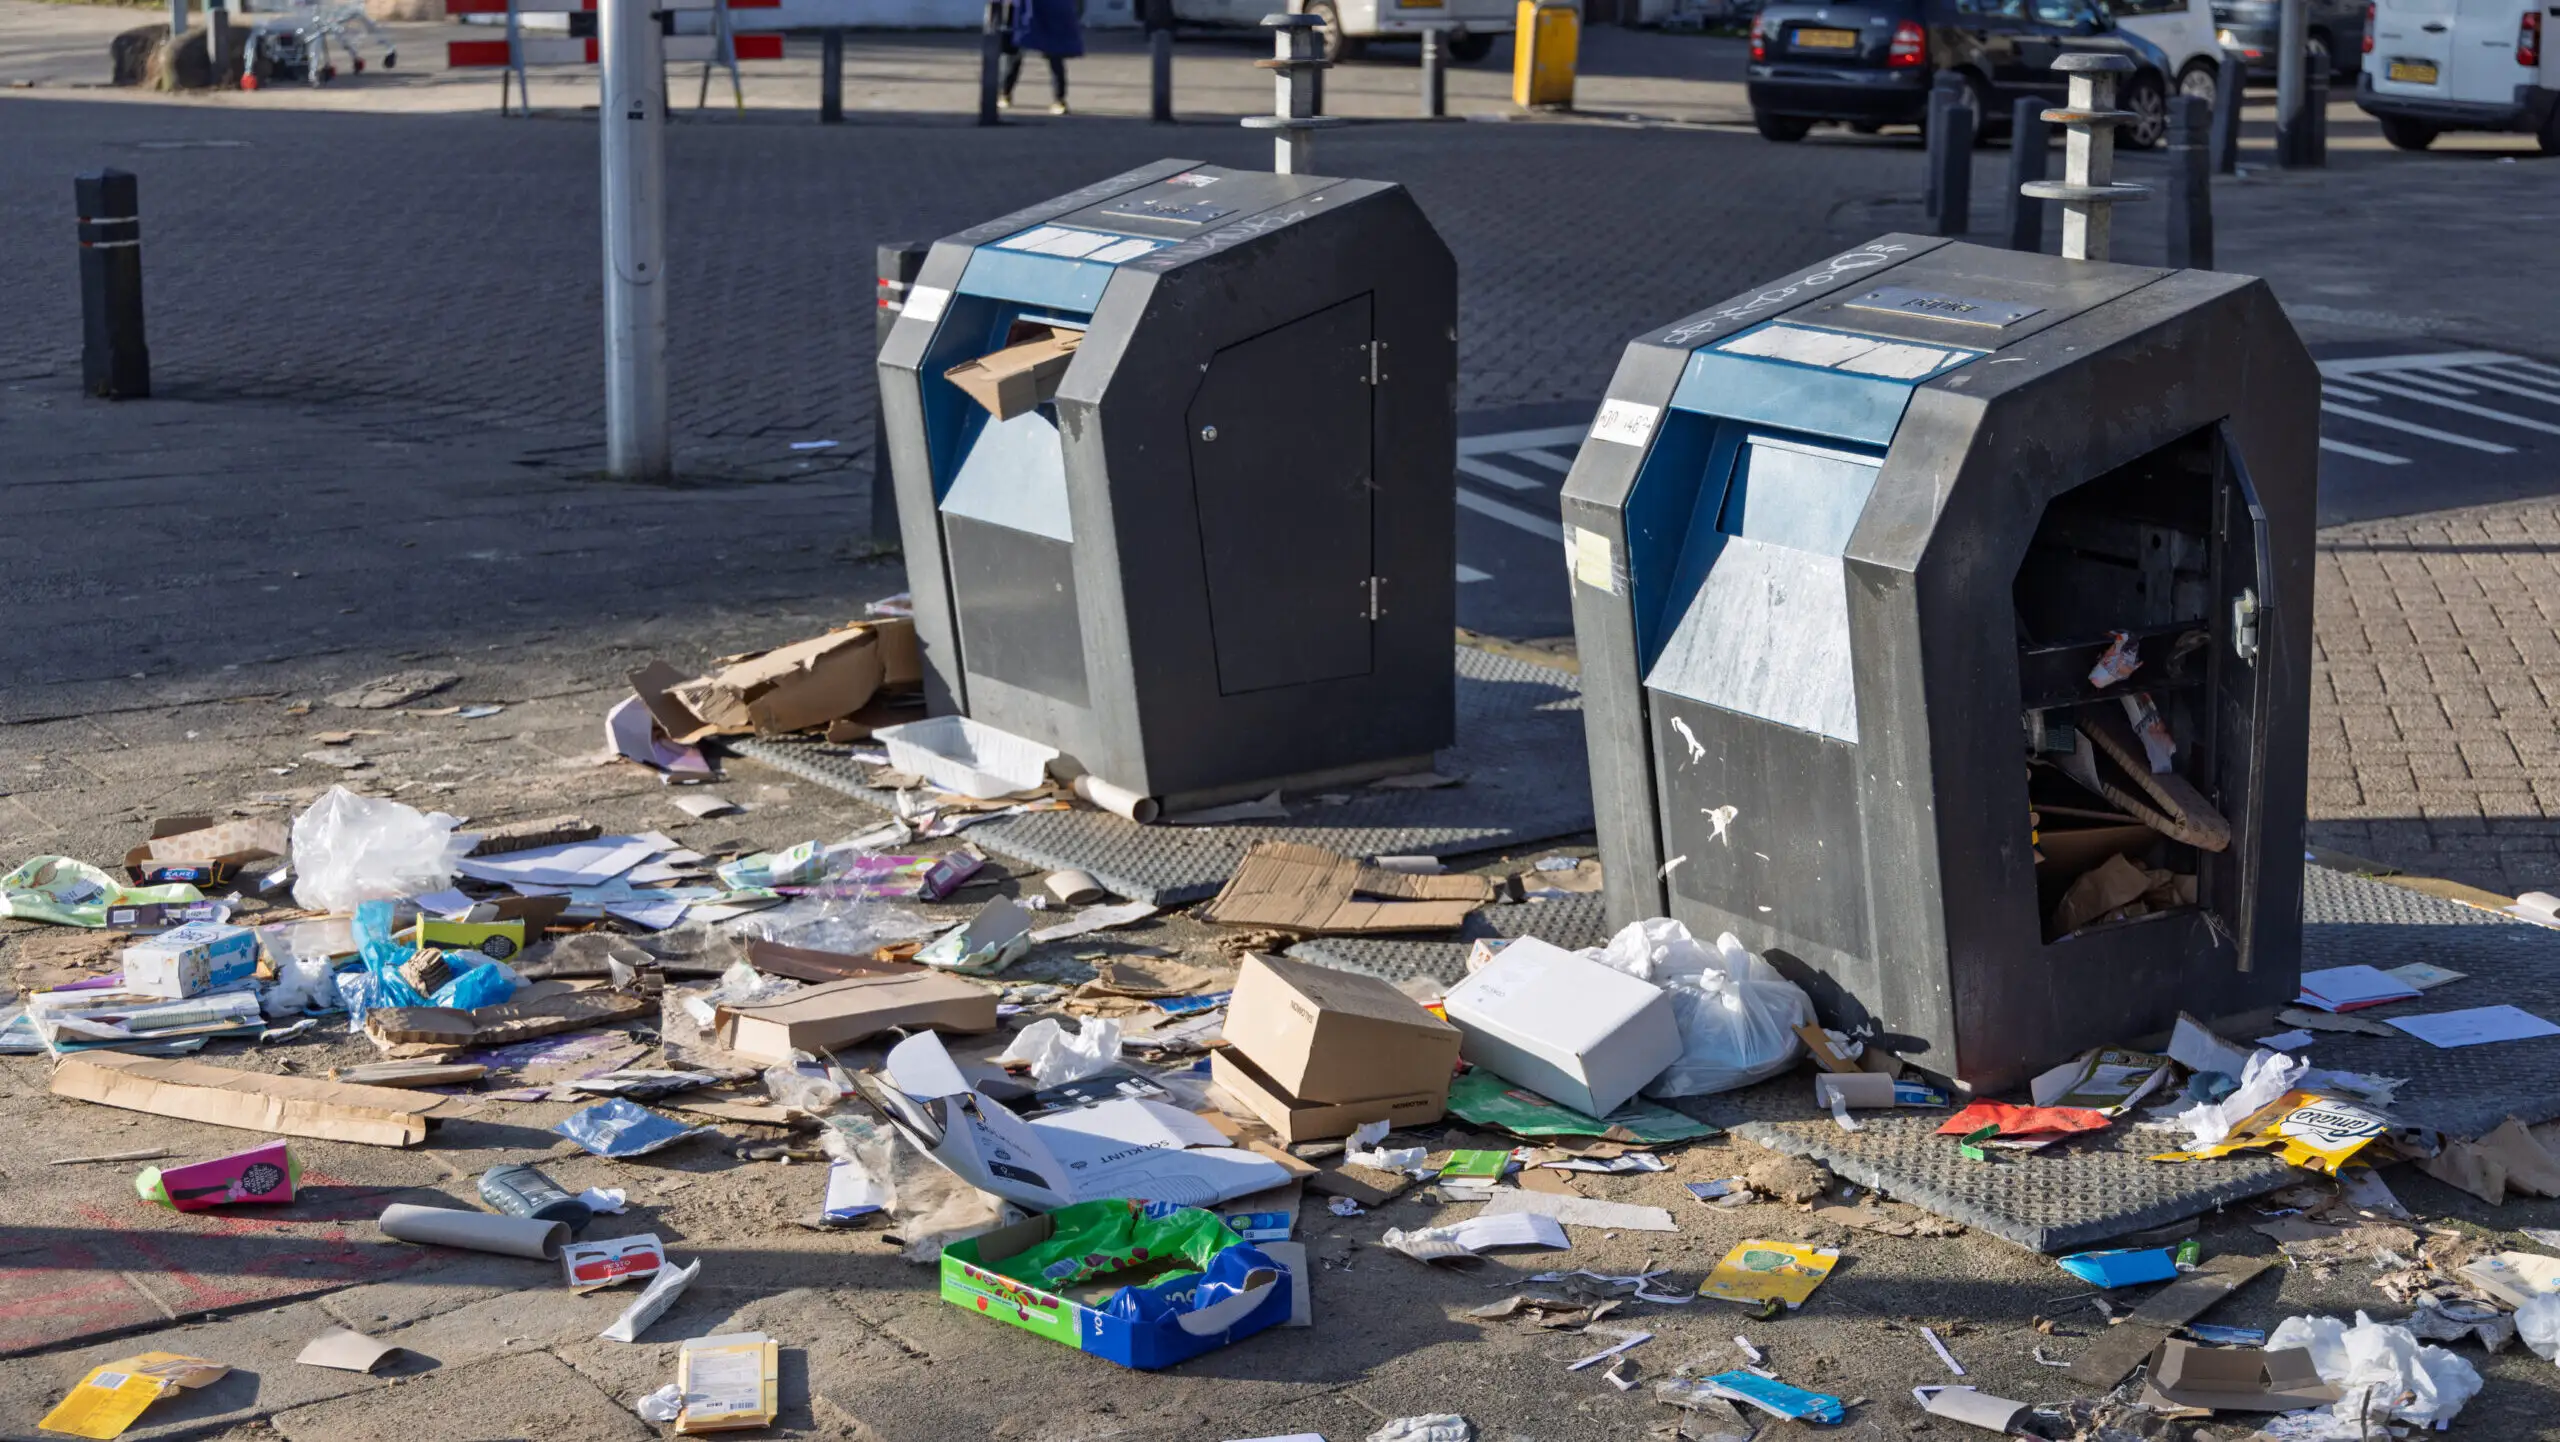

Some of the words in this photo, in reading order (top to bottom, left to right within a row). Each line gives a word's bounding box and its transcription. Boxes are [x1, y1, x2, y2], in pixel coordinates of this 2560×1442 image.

[1290, 1000, 1314, 1024] SALOMON
[1392, 1100, 1429, 1110] SALOMON
[1101, 1140, 1170, 1163] SOLKLINT
